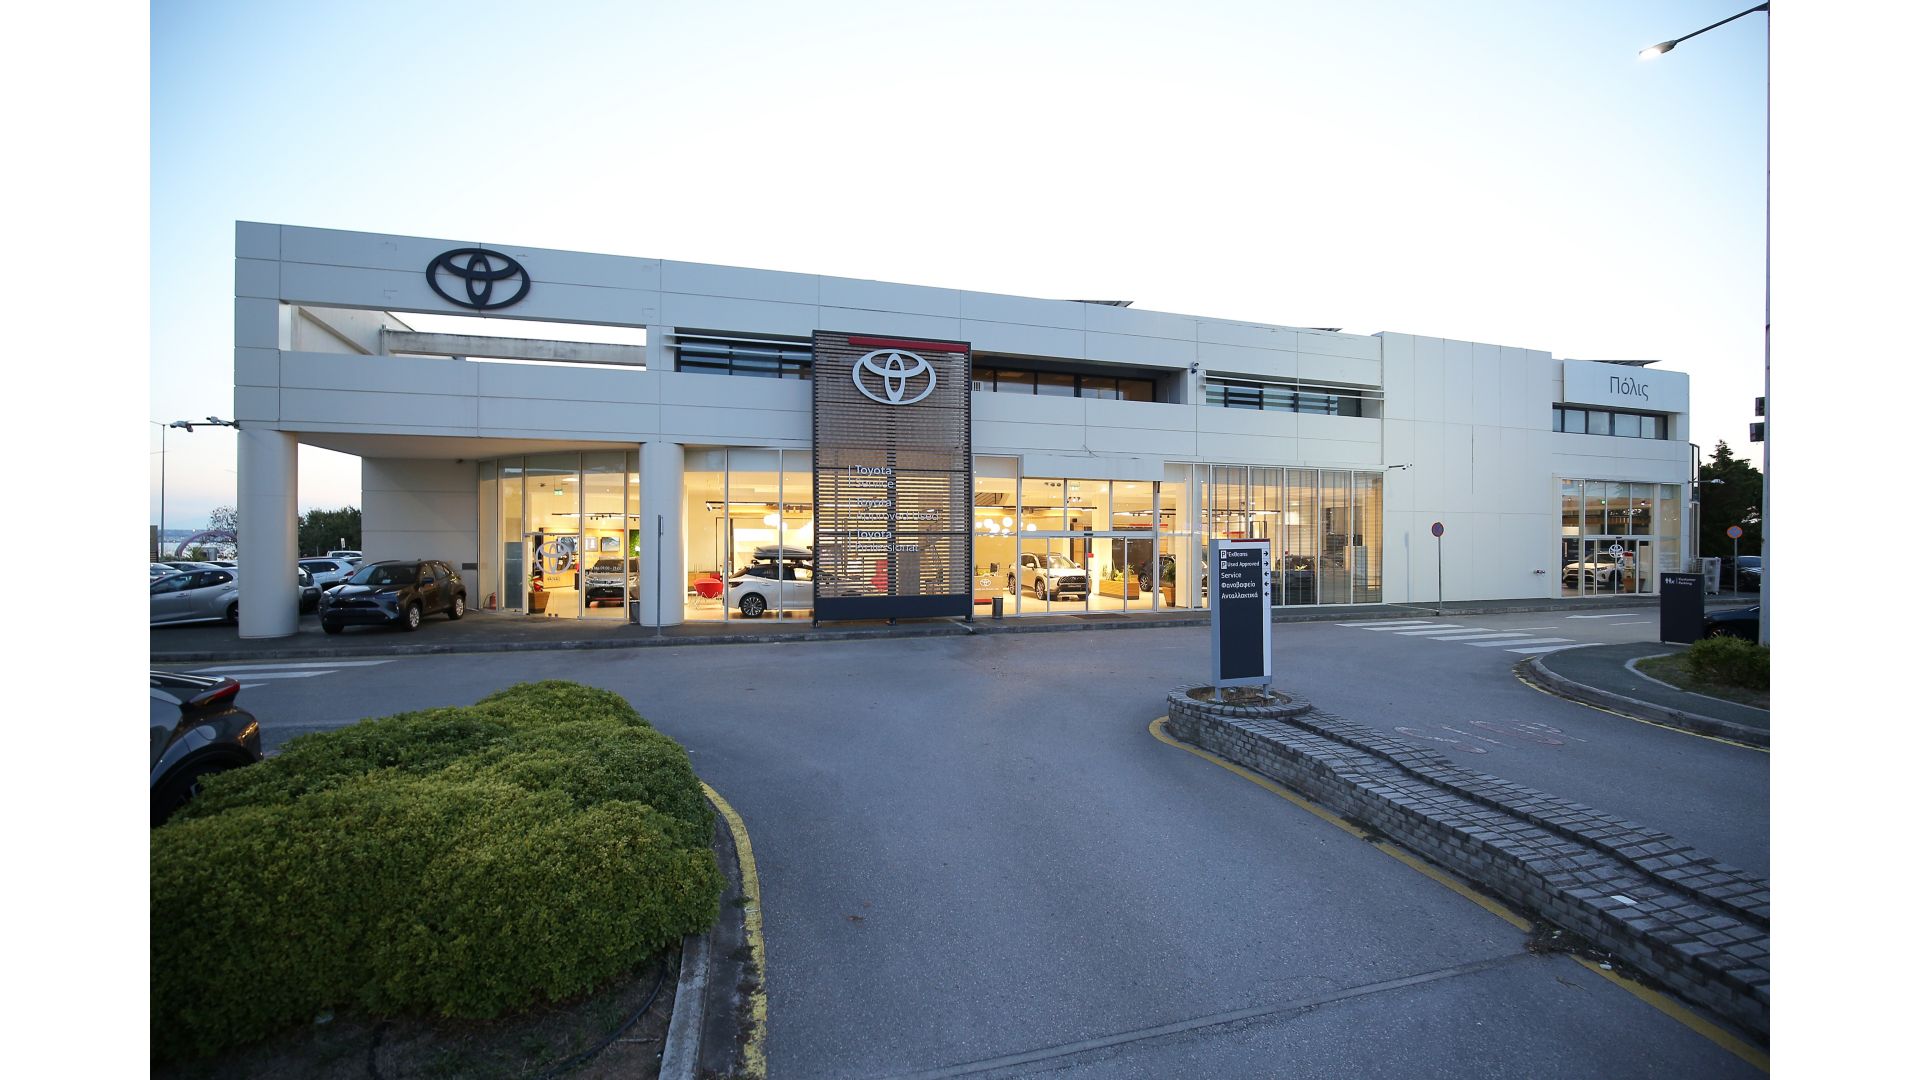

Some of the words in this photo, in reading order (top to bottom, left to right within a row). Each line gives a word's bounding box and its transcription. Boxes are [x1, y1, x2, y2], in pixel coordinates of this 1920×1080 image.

[1610, 376, 1649, 401] Πόλις
[855, 465, 892, 476] Toyota
[855, 497, 892, 509] Toyota
[913, 510, 939, 520] Used
[855, 529, 892, 541] Toyota
[1221, 591, 1258, 599] Ανταλλακτικά
